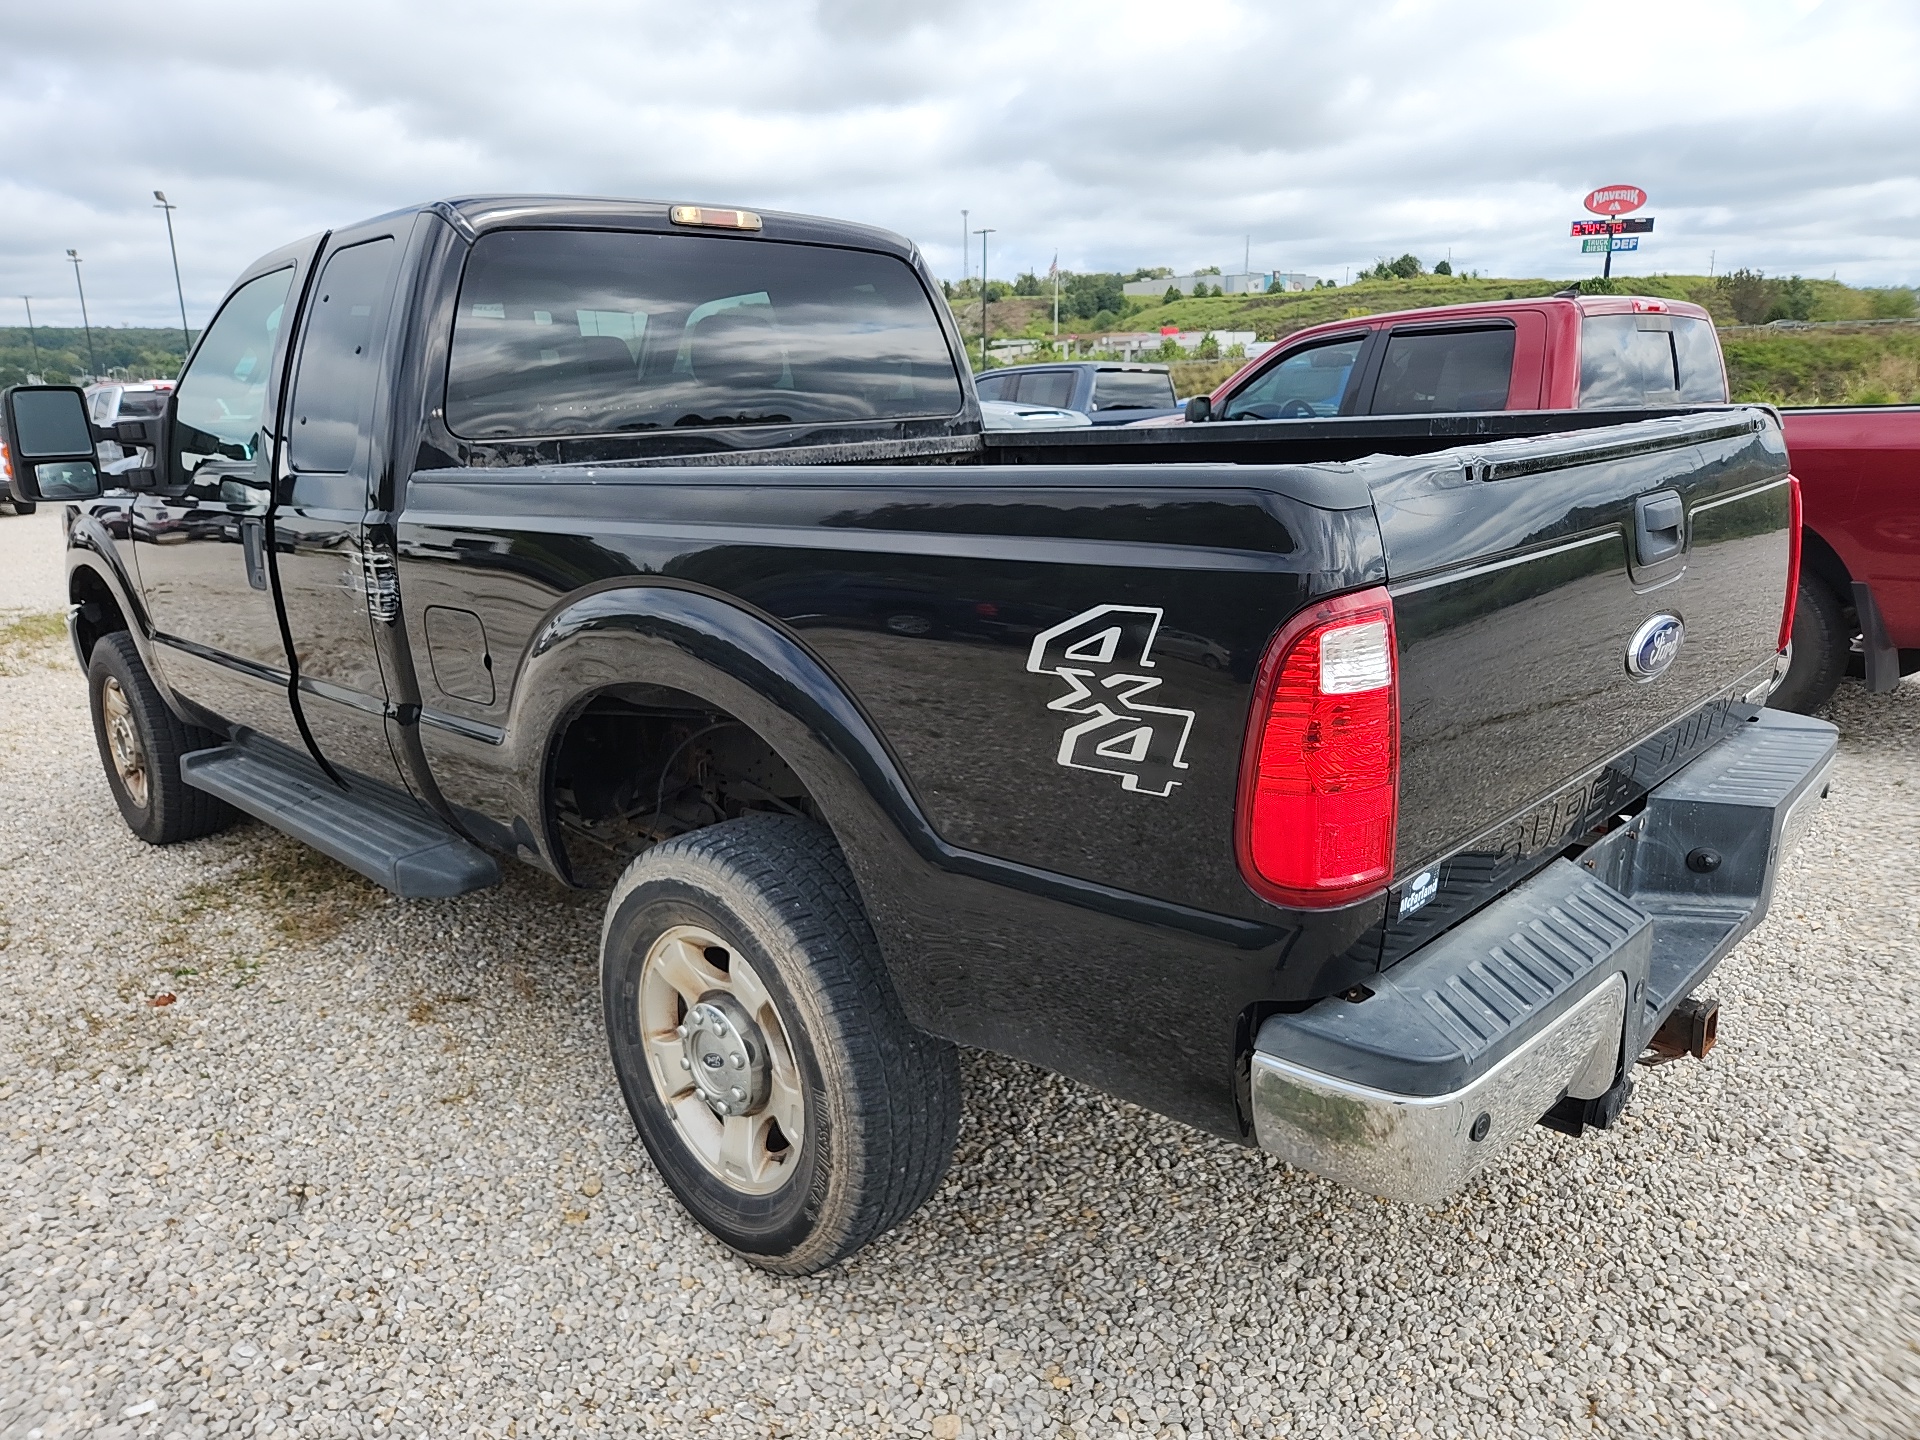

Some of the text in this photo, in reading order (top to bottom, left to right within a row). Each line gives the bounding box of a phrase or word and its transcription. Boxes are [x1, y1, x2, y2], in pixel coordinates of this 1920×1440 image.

[1593, 189, 1639, 207] MAVERIK
[1611, 239, 1638, 250] DEF
[1649, 626, 1680, 666] Ford
[1490, 755, 1637, 882] SUPER
[1400, 878, 1438, 912] McFarland
